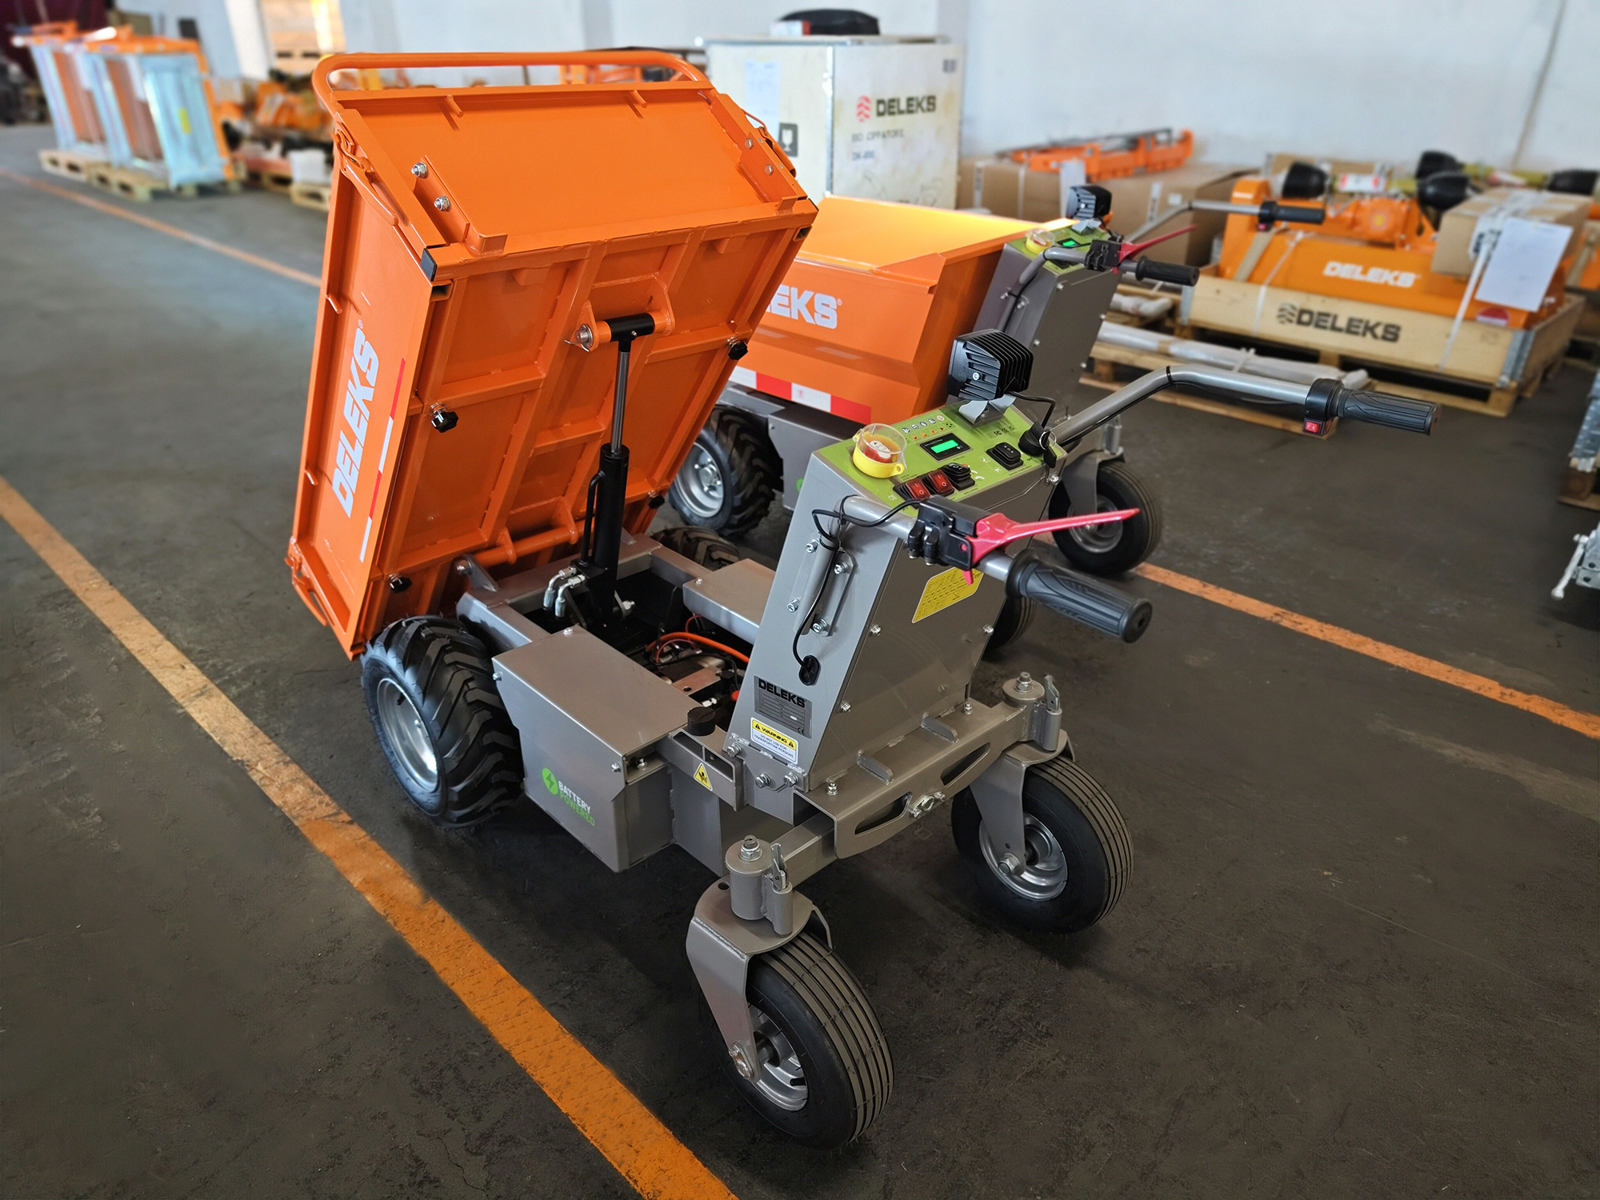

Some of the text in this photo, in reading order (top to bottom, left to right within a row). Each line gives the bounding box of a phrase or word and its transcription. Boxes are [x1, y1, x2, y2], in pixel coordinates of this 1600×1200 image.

[876, 95, 936, 117] DELEKS
[1324, 262, 1415, 287] DELEKS
[766, 284, 837, 329] EKS
[1296, 309, 1401, 342] DELEKS
[332, 327, 379, 518] DELEKS
[758, 678, 805, 708] DELEKS
[558, 780, 591, 814] BATTERY
[559, 791, 595, 826] POWERED
